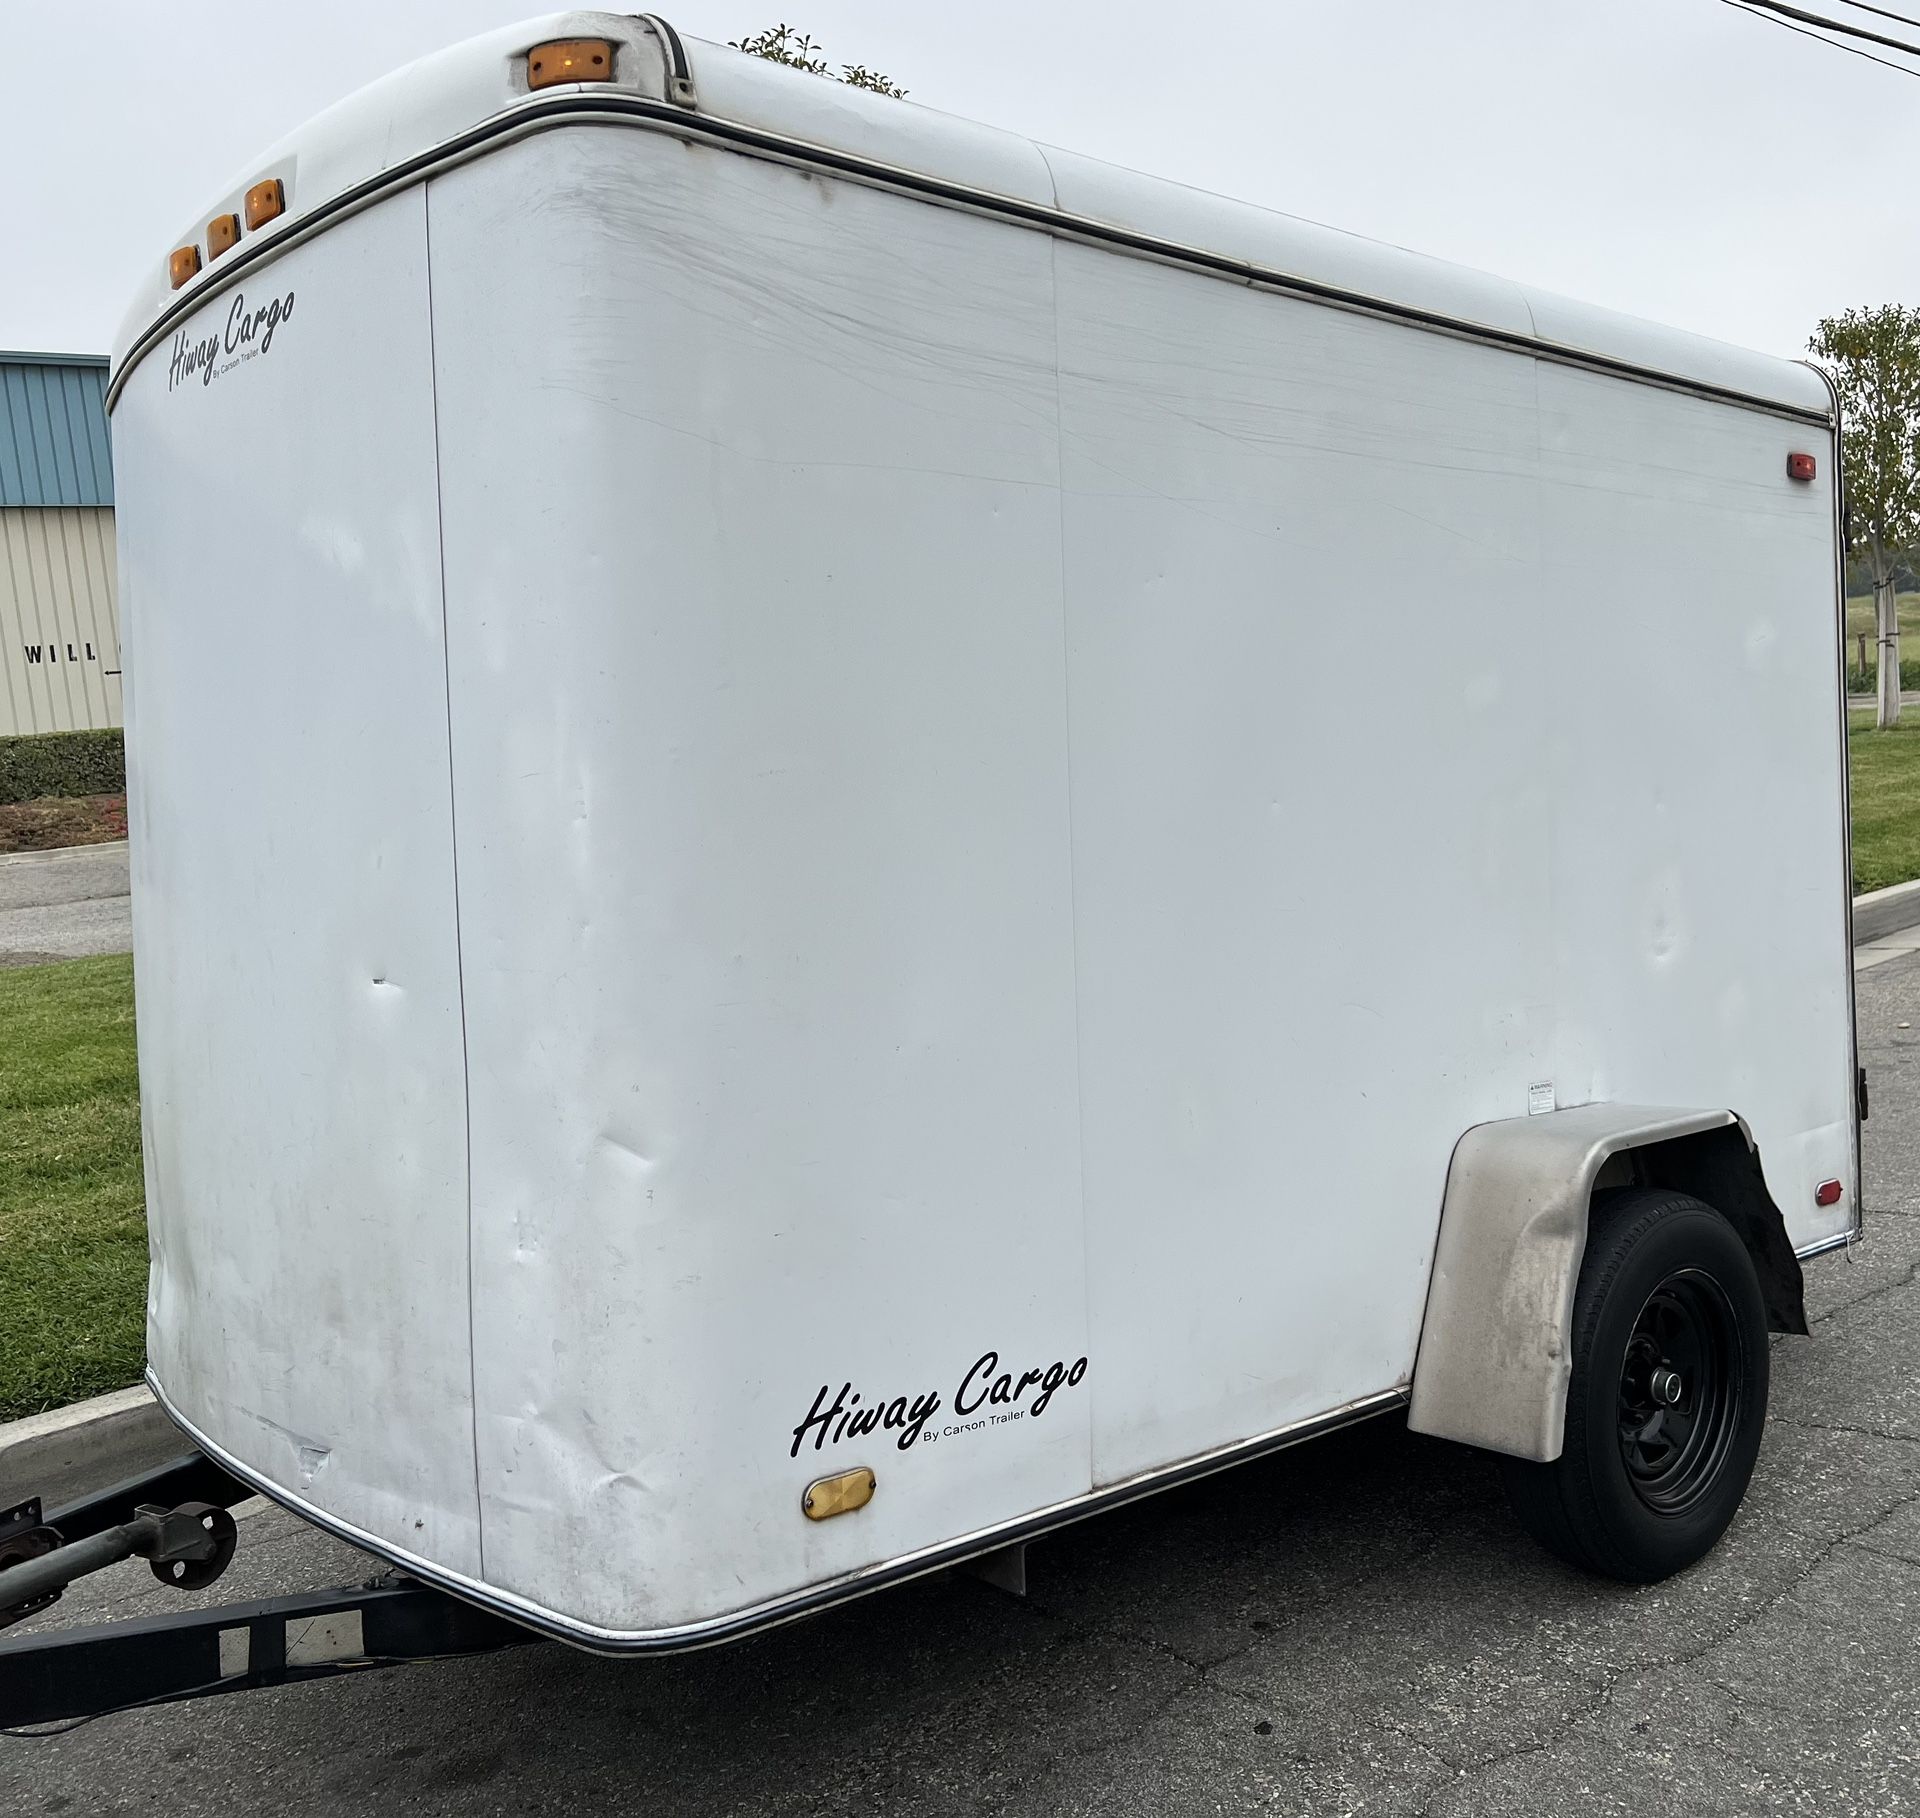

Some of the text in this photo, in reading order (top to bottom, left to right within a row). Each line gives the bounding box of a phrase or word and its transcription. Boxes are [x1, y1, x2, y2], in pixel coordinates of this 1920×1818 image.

[169, 291, 294, 392] Hiway Cargo
[212, 347, 259, 379] By Carson Trailer
[24, 643, 95, 663] WILL
[790, 1351, 1088, 1458] Hiway Cargo
[923, 1410, 1026, 1442] By Carson Trailer
